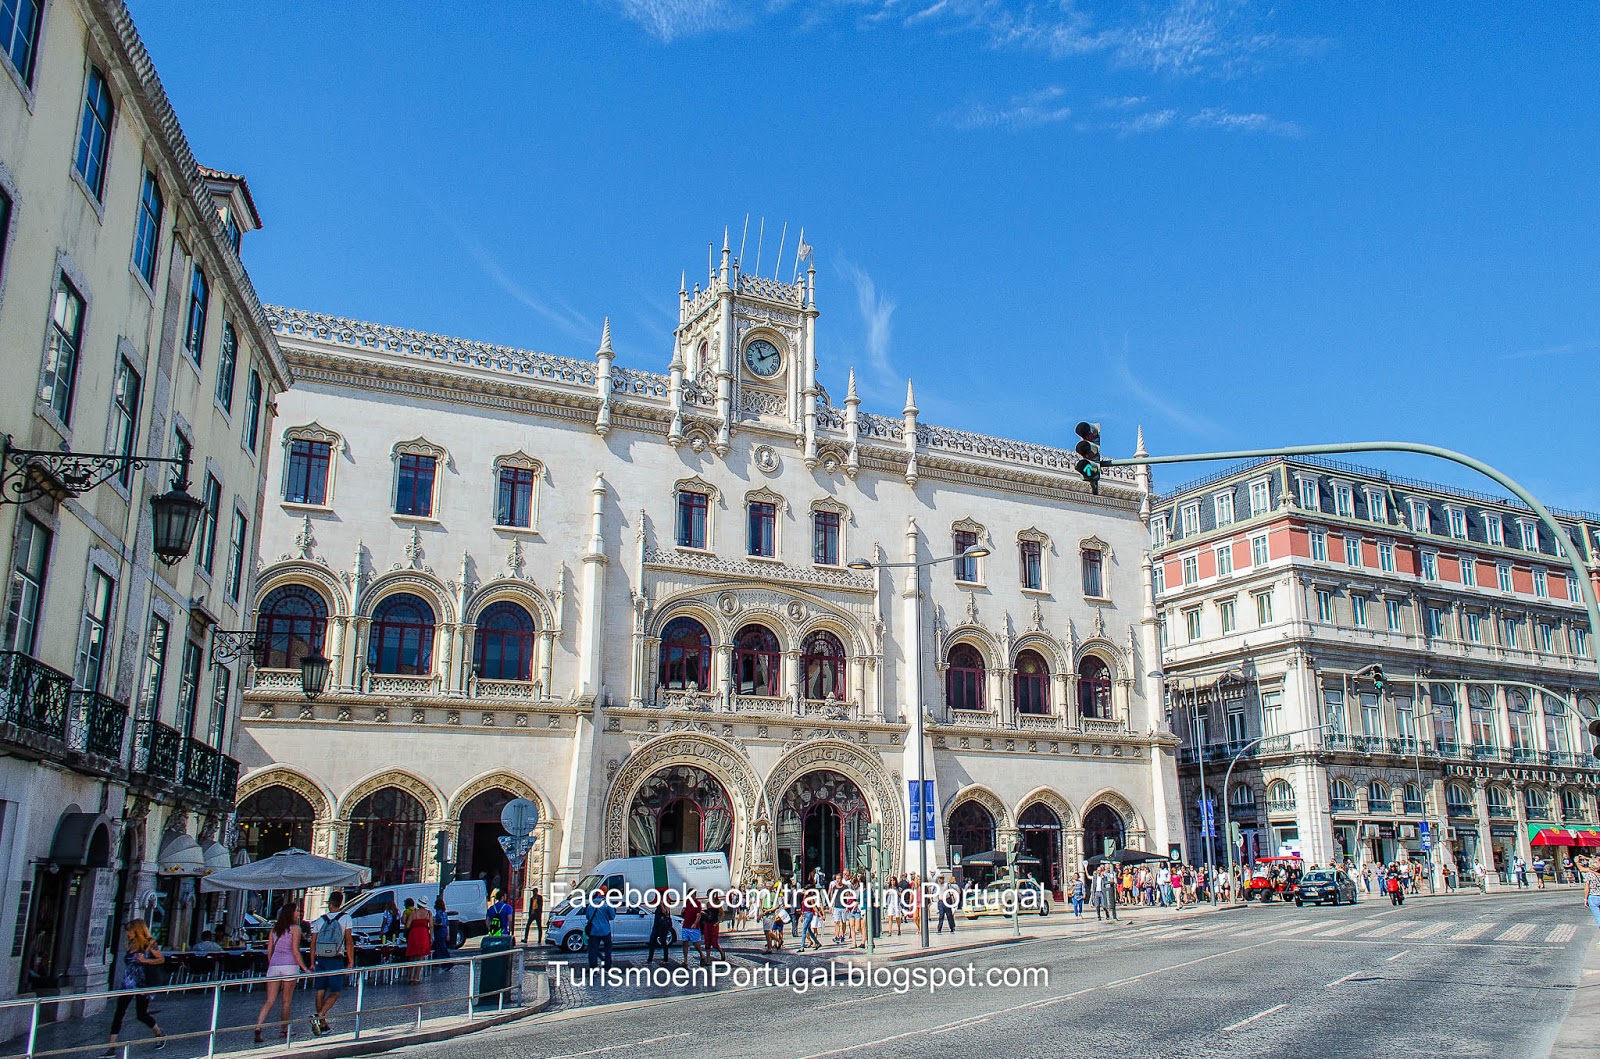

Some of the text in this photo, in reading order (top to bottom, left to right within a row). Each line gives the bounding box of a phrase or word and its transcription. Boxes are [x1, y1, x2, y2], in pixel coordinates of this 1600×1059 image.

[1446, 764, 1493, 778] HOTEL
[1502, 768, 1567, 783] AVENIDA
[689, 858, 721, 866] JCDecaux
